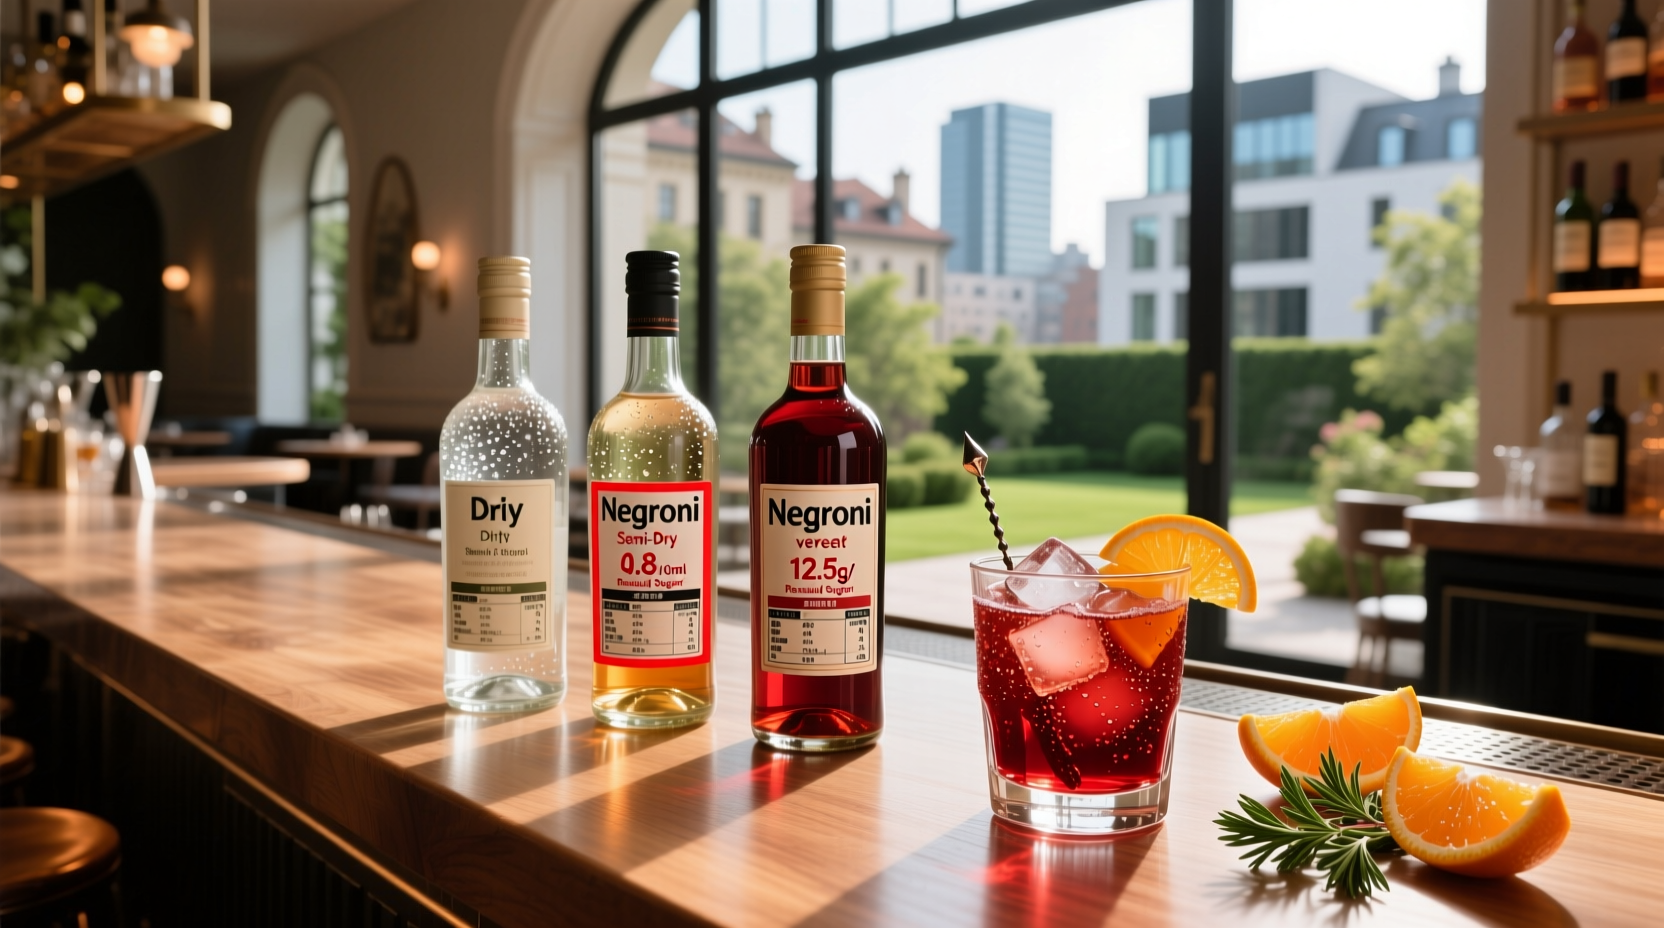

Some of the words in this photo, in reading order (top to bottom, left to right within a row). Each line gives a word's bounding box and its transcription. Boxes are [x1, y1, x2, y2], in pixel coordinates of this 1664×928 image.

[471, 496, 524, 528] Driy
[601, 495, 699, 530] Negroni
[768, 497, 871, 533] Negroni
[789, 557, 855, 585] 12.5g/
